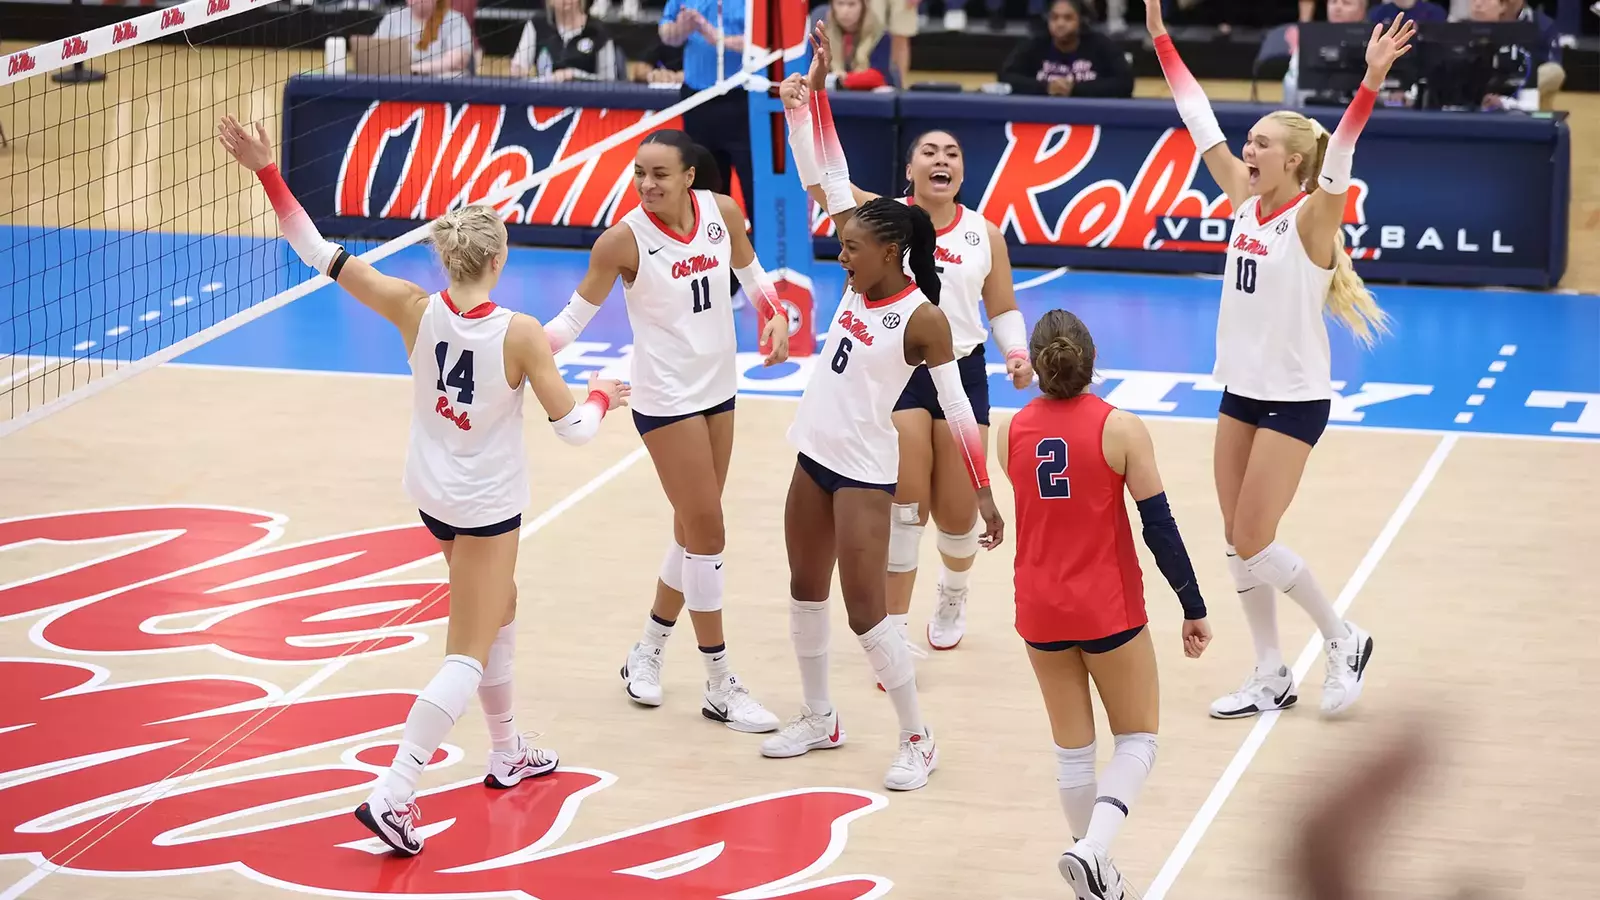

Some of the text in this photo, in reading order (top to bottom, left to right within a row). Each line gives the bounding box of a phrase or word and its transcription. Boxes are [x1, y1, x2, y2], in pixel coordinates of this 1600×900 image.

[112, 21, 138, 45] Ole Miss
[161, 7, 185, 30] Ole Miss
[8, 51, 36, 76] Ole Miss
[62, 36, 88, 60] Ole Miss
[1163, 217, 1515, 253] VOYBALL
[1233, 233, 1268, 256] Ole Miss
[672, 254, 719, 279] Ole Miss
[1236, 256, 1257, 294] 10
[691, 276, 712, 313] 11
[838, 311, 875, 346] Ole Miss
[435, 341, 475, 405] 14
[831, 336, 853, 375] 6
[1036, 437, 1070, 499] 2
